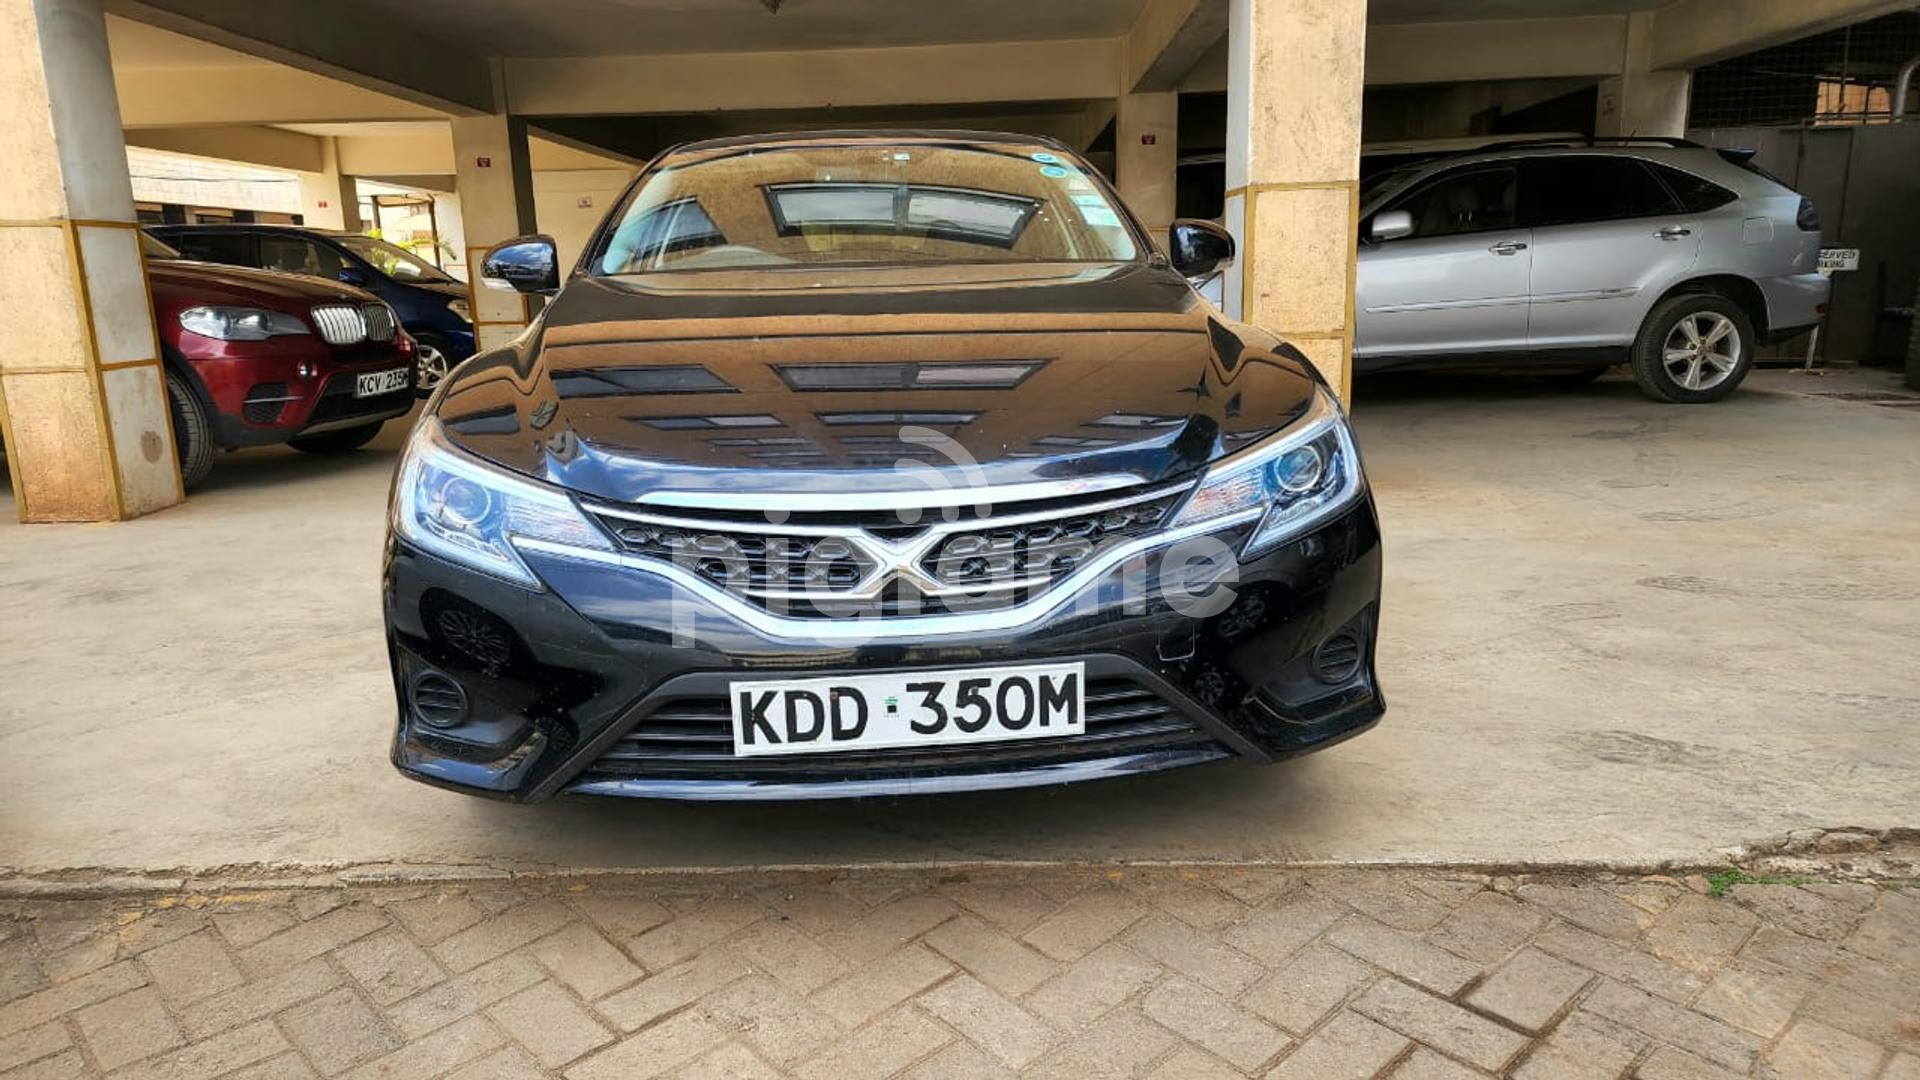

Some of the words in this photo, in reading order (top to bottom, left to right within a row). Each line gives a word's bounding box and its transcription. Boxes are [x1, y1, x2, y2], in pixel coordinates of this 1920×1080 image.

[360, 374, 381, 394] KCV
[740, 687, 869, 745] KDD
[906, 673, 1078, 735] 350M
